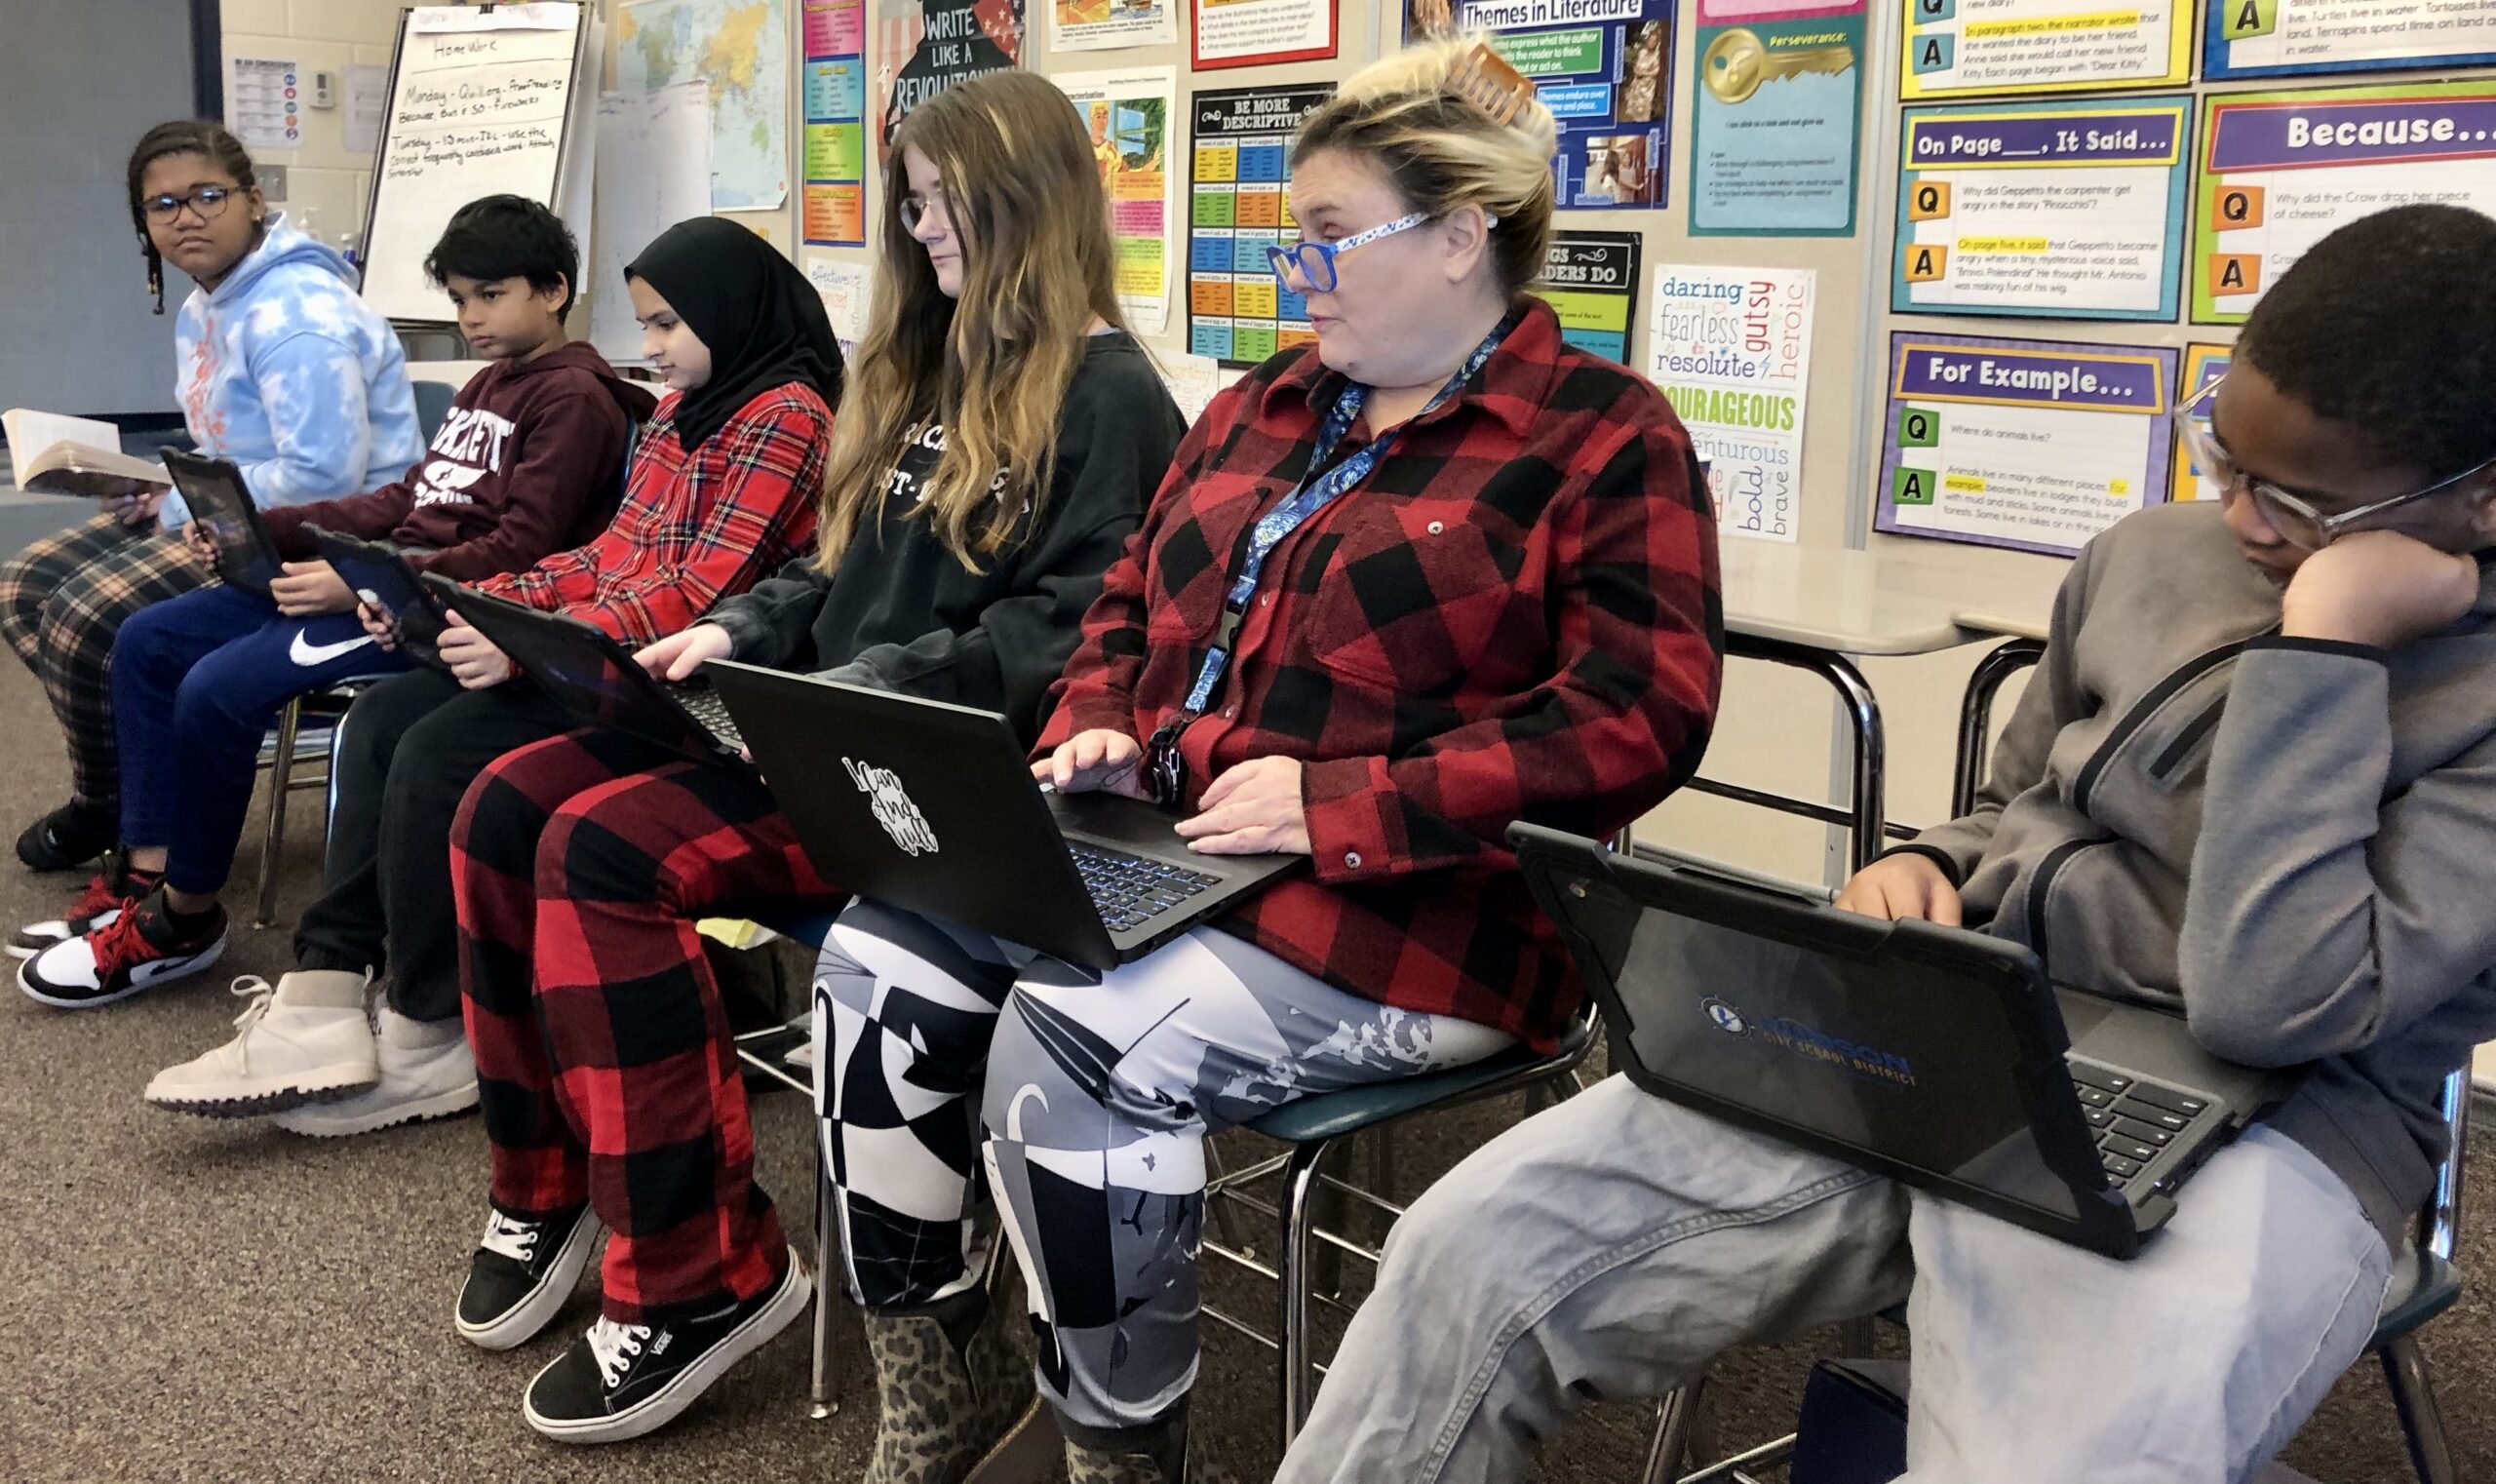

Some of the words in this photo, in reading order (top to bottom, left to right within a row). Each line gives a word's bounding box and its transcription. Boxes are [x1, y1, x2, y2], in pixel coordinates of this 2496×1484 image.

[925, 8, 974, 41] WRITE
[1465, 5, 1528, 26] Themes
[1532, 2, 1545, 20] in
[1551, 0, 1638, 20] Literature
[2236, 1, 2260, 30] A
[1559, 34, 1570, 45] the
[1571, 33, 1598, 43] author
[1923, 39, 1941, 65] A
[932, 45, 959, 67] LIKE
[965, 42, 972, 63] A
[1234, 100, 1253, 115] BE
[1256, 98, 1290, 113] MORE
[1223, 114, 1302, 130] DESCRIPTIVE
[1918, 137, 1945, 155] On
[2055, 132, 2080, 152] It
[1918, 187, 1938, 213] Q
[2223, 192, 2248, 221] Q
[1543, 265, 1586, 281] DERS
[1590, 266, 1617, 283] DO
[1914, 250, 1932, 275] A
[2221, 259, 2243, 288] A
[1663, 277, 1743, 304] daring
[1660, 303, 1738, 345] fearless
[1744, 282, 1775, 352] gutsy
[1770, 284, 1804, 380] heroic
[1658, 352, 1755, 377] resolute
[1929, 358, 1972, 383] For
[1907, 414, 1927, 441] Q
[1694, 438, 1788, 465] enturous
[1737, 465, 1763, 530] bold
[1903, 473, 1921, 498] A
[1766, 471, 1788, 535] brave
[1797, 1042, 1849, 1066] SCHOOL
[1853, 1058, 1916, 1086] DISTRICT
